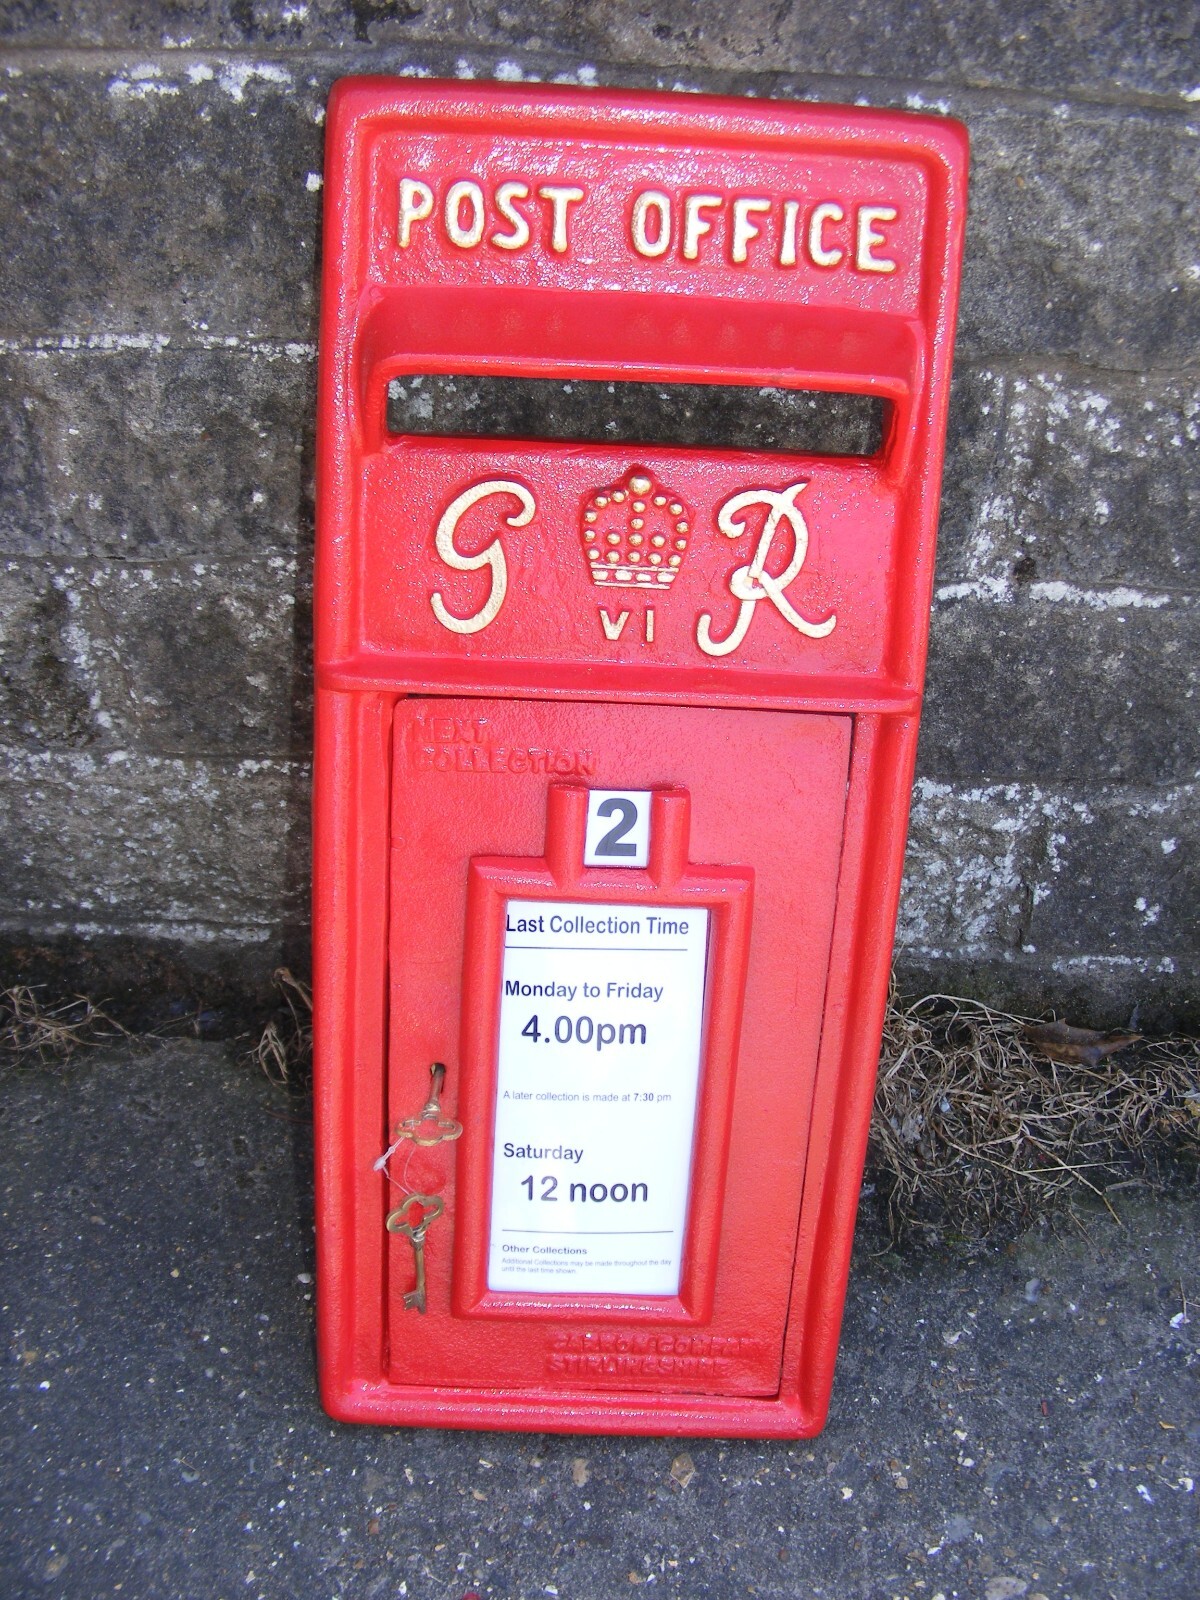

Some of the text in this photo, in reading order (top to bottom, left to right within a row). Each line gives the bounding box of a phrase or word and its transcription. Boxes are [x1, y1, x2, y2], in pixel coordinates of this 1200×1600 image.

[397, 177, 898, 273] POST OFFICE
[430, 480, 837, 657] G R
[600, 609, 654, 643] VI
[412, 746, 595, 775] COLLECTION
[594, 798, 638, 857] 2
[506, 914, 689, 935] Last Collection Time
[505, 980, 664, 1002] Monday to Friday
[521, 1014, 647, 1051] 4.00pm
[503, 1090, 672, 1103] A later collection is made at 7:30 pm
[503, 1143, 584, 1164] Saturday
[520, 1174, 649, 1203] 12 noon
[502, 1244, 588, 1255] Other Collections
